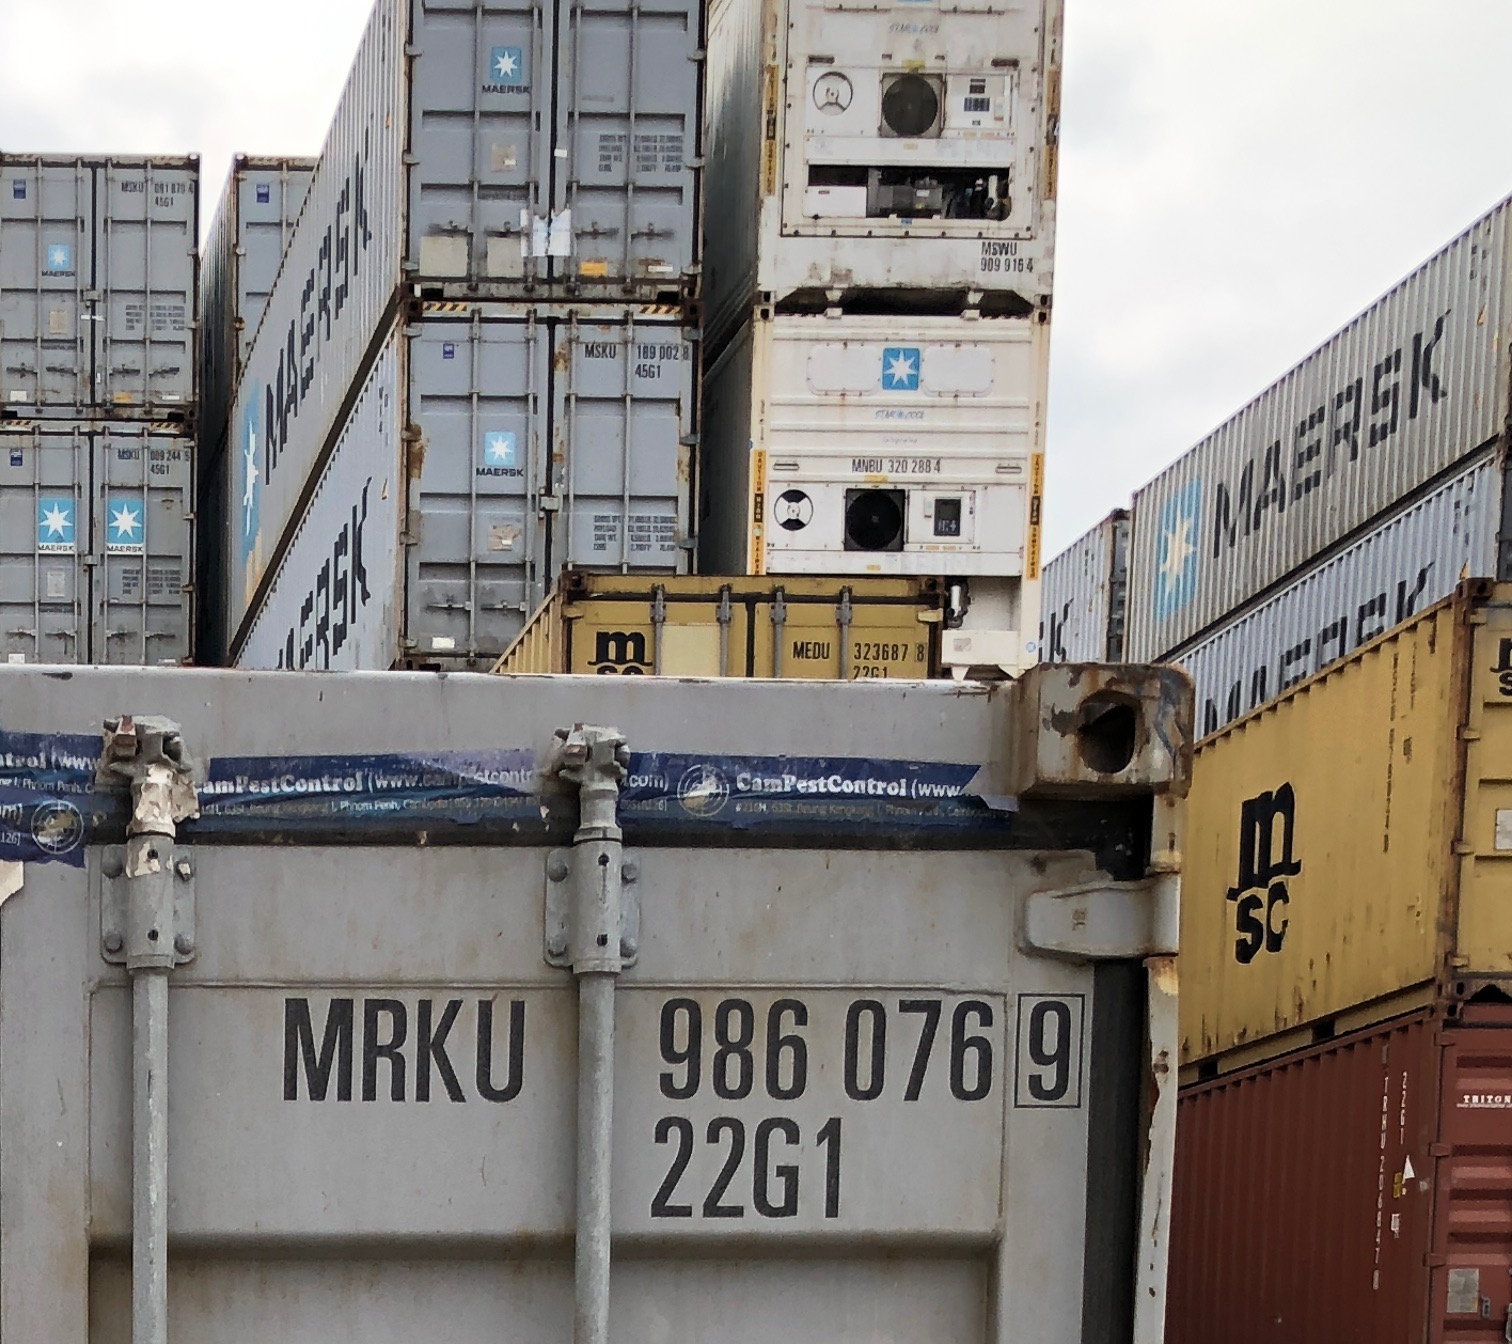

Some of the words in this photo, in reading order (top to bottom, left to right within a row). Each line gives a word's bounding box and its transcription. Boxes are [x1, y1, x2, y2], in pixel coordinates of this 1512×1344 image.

[482, 84, 530, 94] MAERSK
[981, 242, 1018, 256] MSWU
[264, 127, 373, 484] MAERSK
[584, 343, 616, 359] MSKU
[637, 345, 656, 359] 189
[634, 364, 661, 378] 45G1
[1213, 309, 1452, 558] MAERSK
[476, 468, 524, 477] MAERSK
[852, 458, 883, 473] MNBU
[888, 459, 907, 472] 320
[911, 459, 931, 473] 288
[793, 641, 830, 660] MEDU
[854, 643, 909, 661] 323687
[916, 644, 926, 662] 8
[736, 773, 908, 798] CamPestControl
[282, 998, 524, 1102] MRKU
[657, 998, 809, 1101] 986
[844, 998, 994, 1101] 076
[1027, 1000, 1072, 1101] 9
[1463, 1095, 1511, 1104] TRITON
[650, 1116, 843, 1219] 22G1
